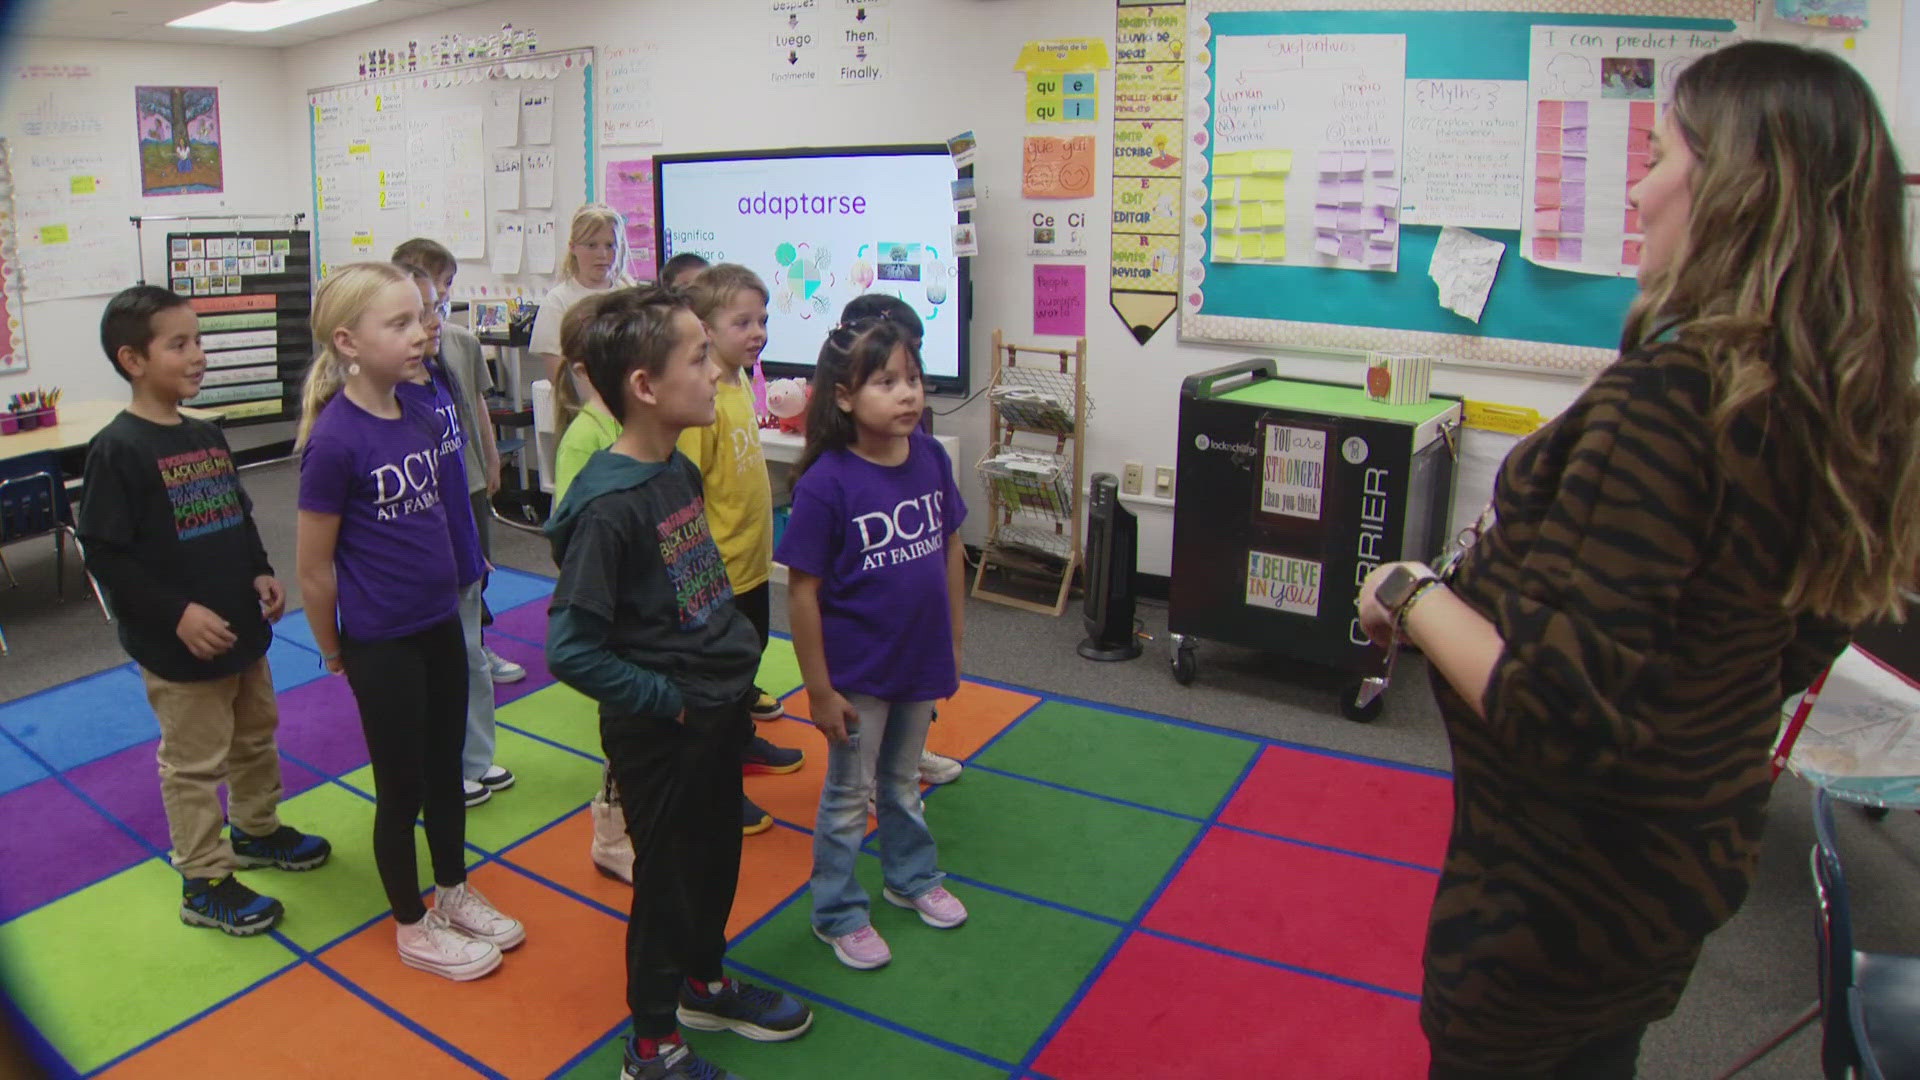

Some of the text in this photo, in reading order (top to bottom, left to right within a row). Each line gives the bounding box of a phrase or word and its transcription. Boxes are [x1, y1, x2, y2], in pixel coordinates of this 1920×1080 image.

[775, 34, 811, 47] Luego
[1546, 30, 1721, 53] I can predict that
[771, 71, 816, 82] Finalmente
[1036, 80, 1083, 95] qu e
[1430, 81, 1481, 104] Myths
[376, 95, 382, 112] 2
[1036, 102, 1080, 120] qu i
[1141, 179, 1150, 189] E
[380, 192, 386, 208] 2
[737, 191, 867, 220] adaptarse
[1032, 212, 1085, 228] Ce Ci
[673, 229, 715, 243] significa
[1140, 236, 1149, 246] R
[717, 250, 725, 260] o
[1273, 426, 1323, 453] YOU are
[1264, 455, 1321, 489] STRONGER
[1263, 487, 1280, 509] than
[1280, 493, 1296, 512] you
[377, 503, 399, 521] AT
[862, 550, 887, 571] AT
[1249, 553, 1318, 587] I BELIEVE
[1249, 578, 1317, 608] IN you
